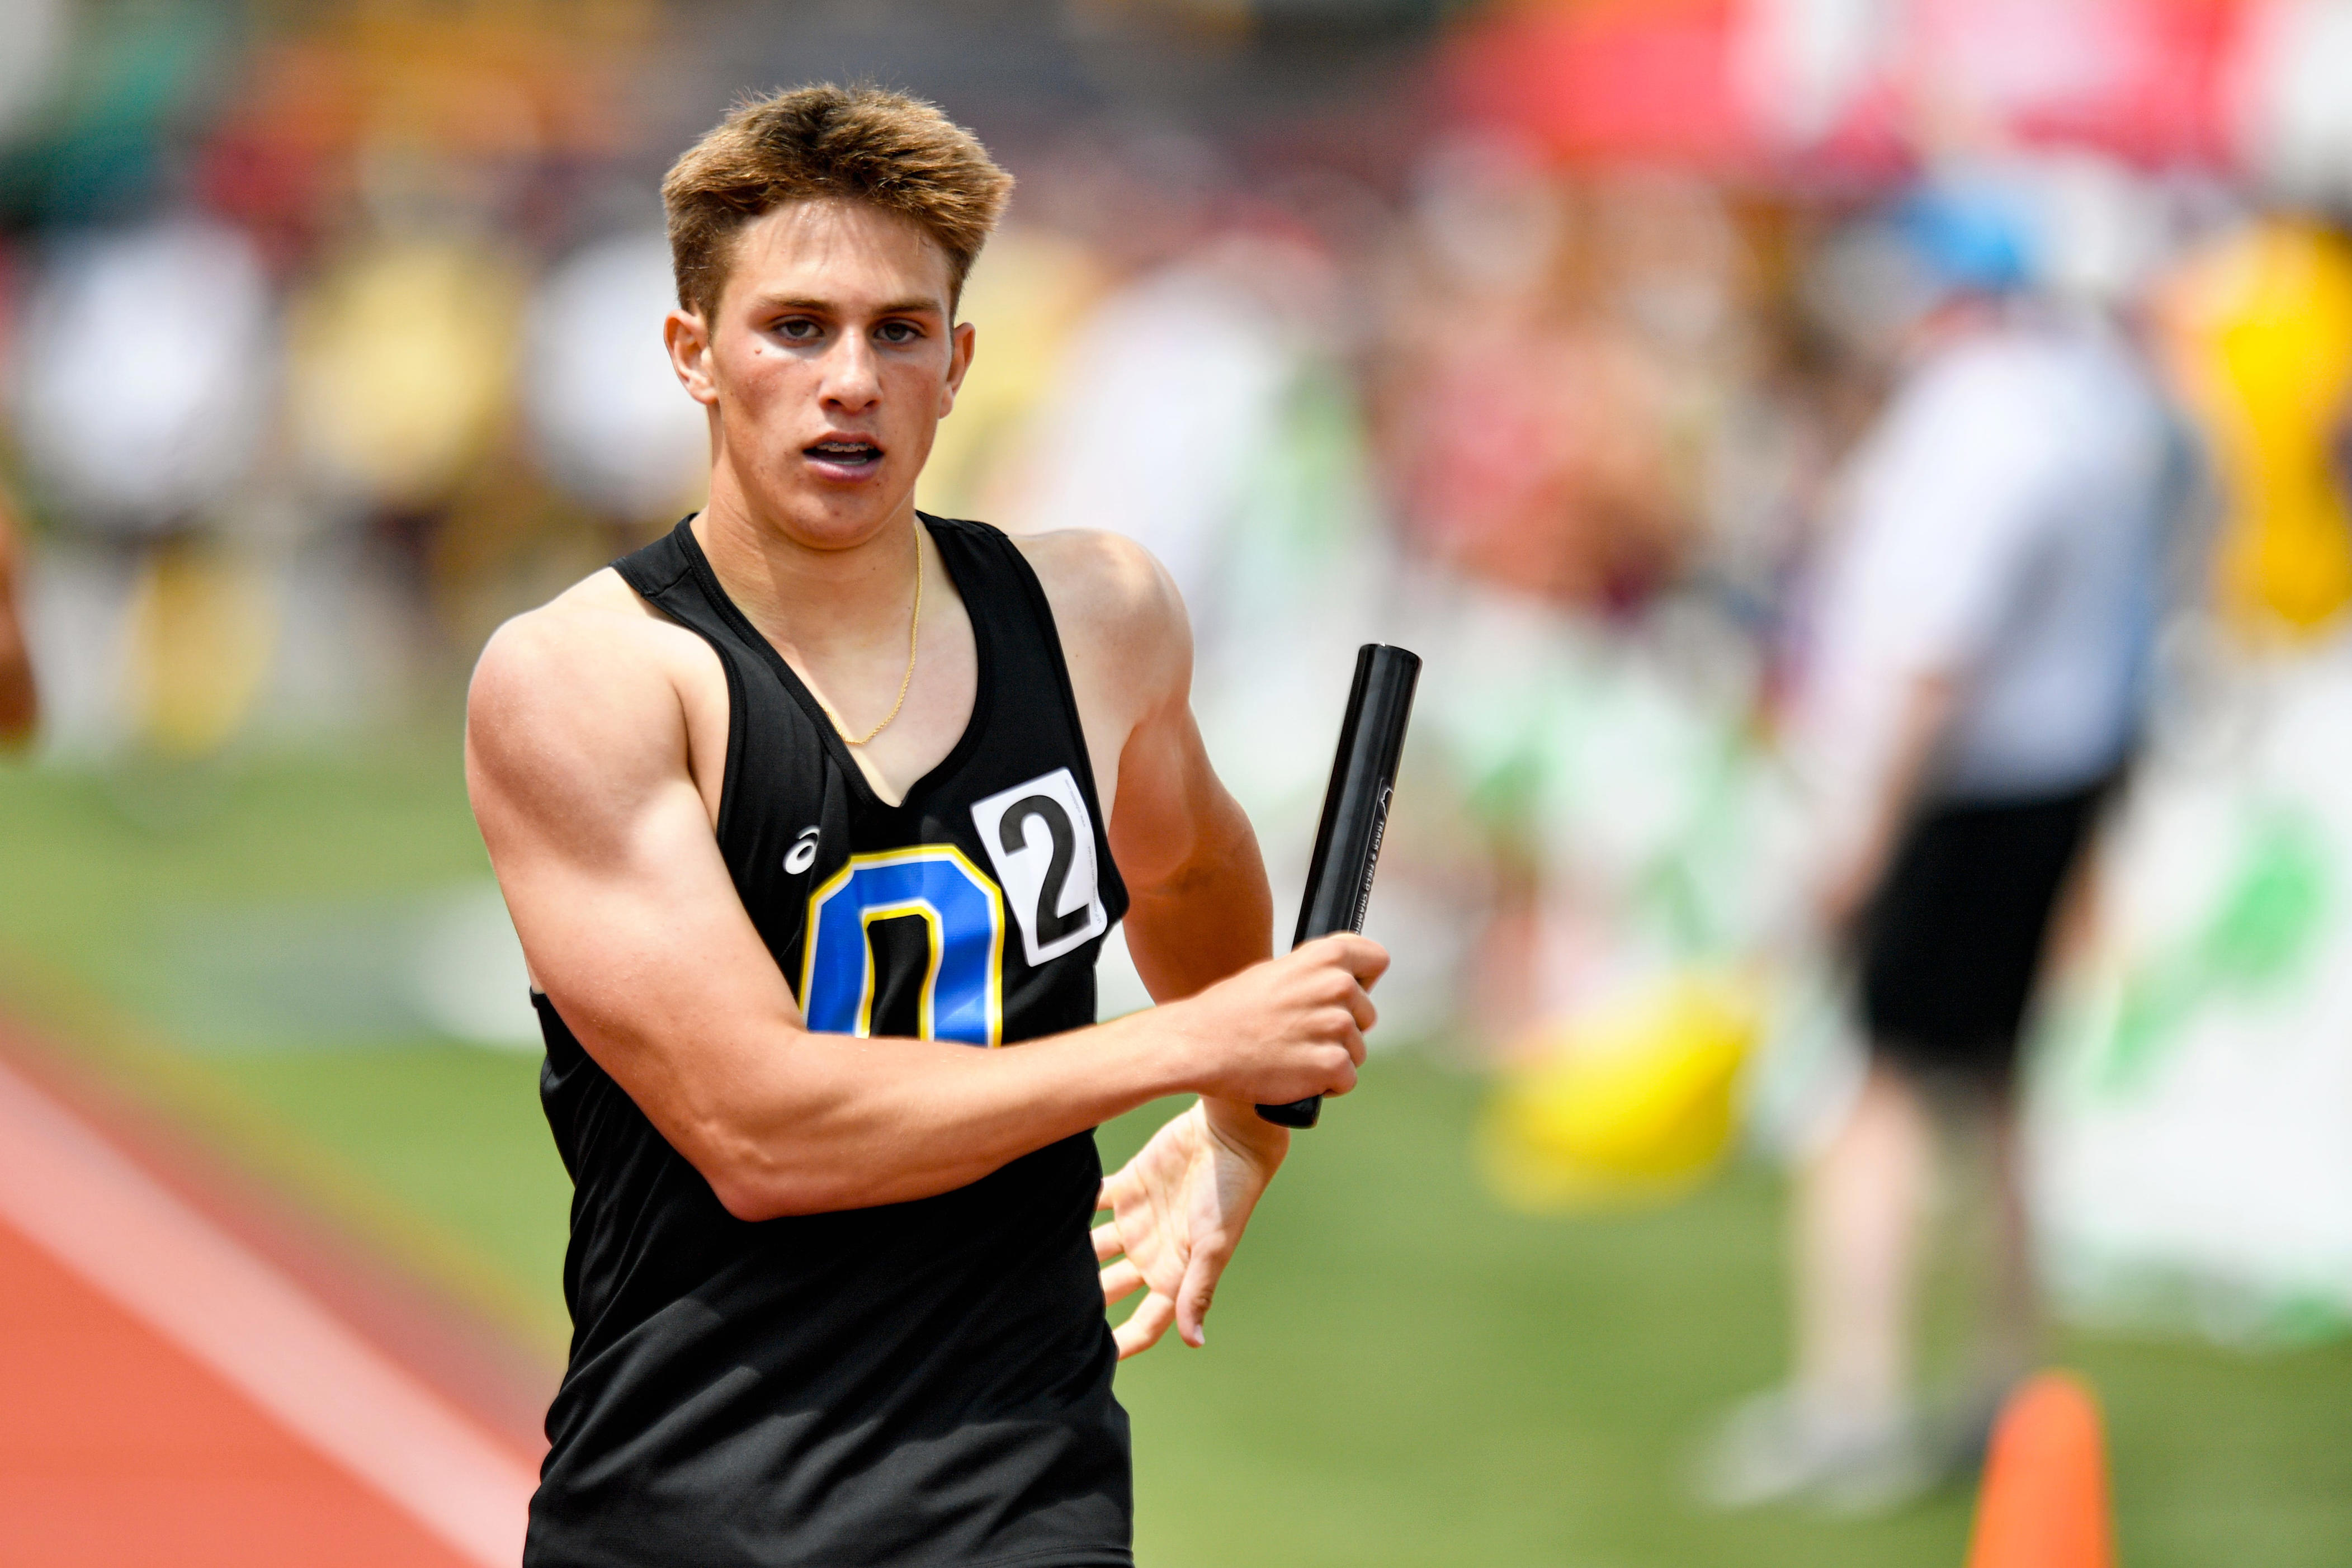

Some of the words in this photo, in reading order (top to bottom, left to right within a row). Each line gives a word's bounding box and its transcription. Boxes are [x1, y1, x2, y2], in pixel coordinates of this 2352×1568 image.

[1373, 820, 1385, 852] TRACK
[999, 795, 1091, 951] 2
[1364, 864, 1375, 891] FIELD
